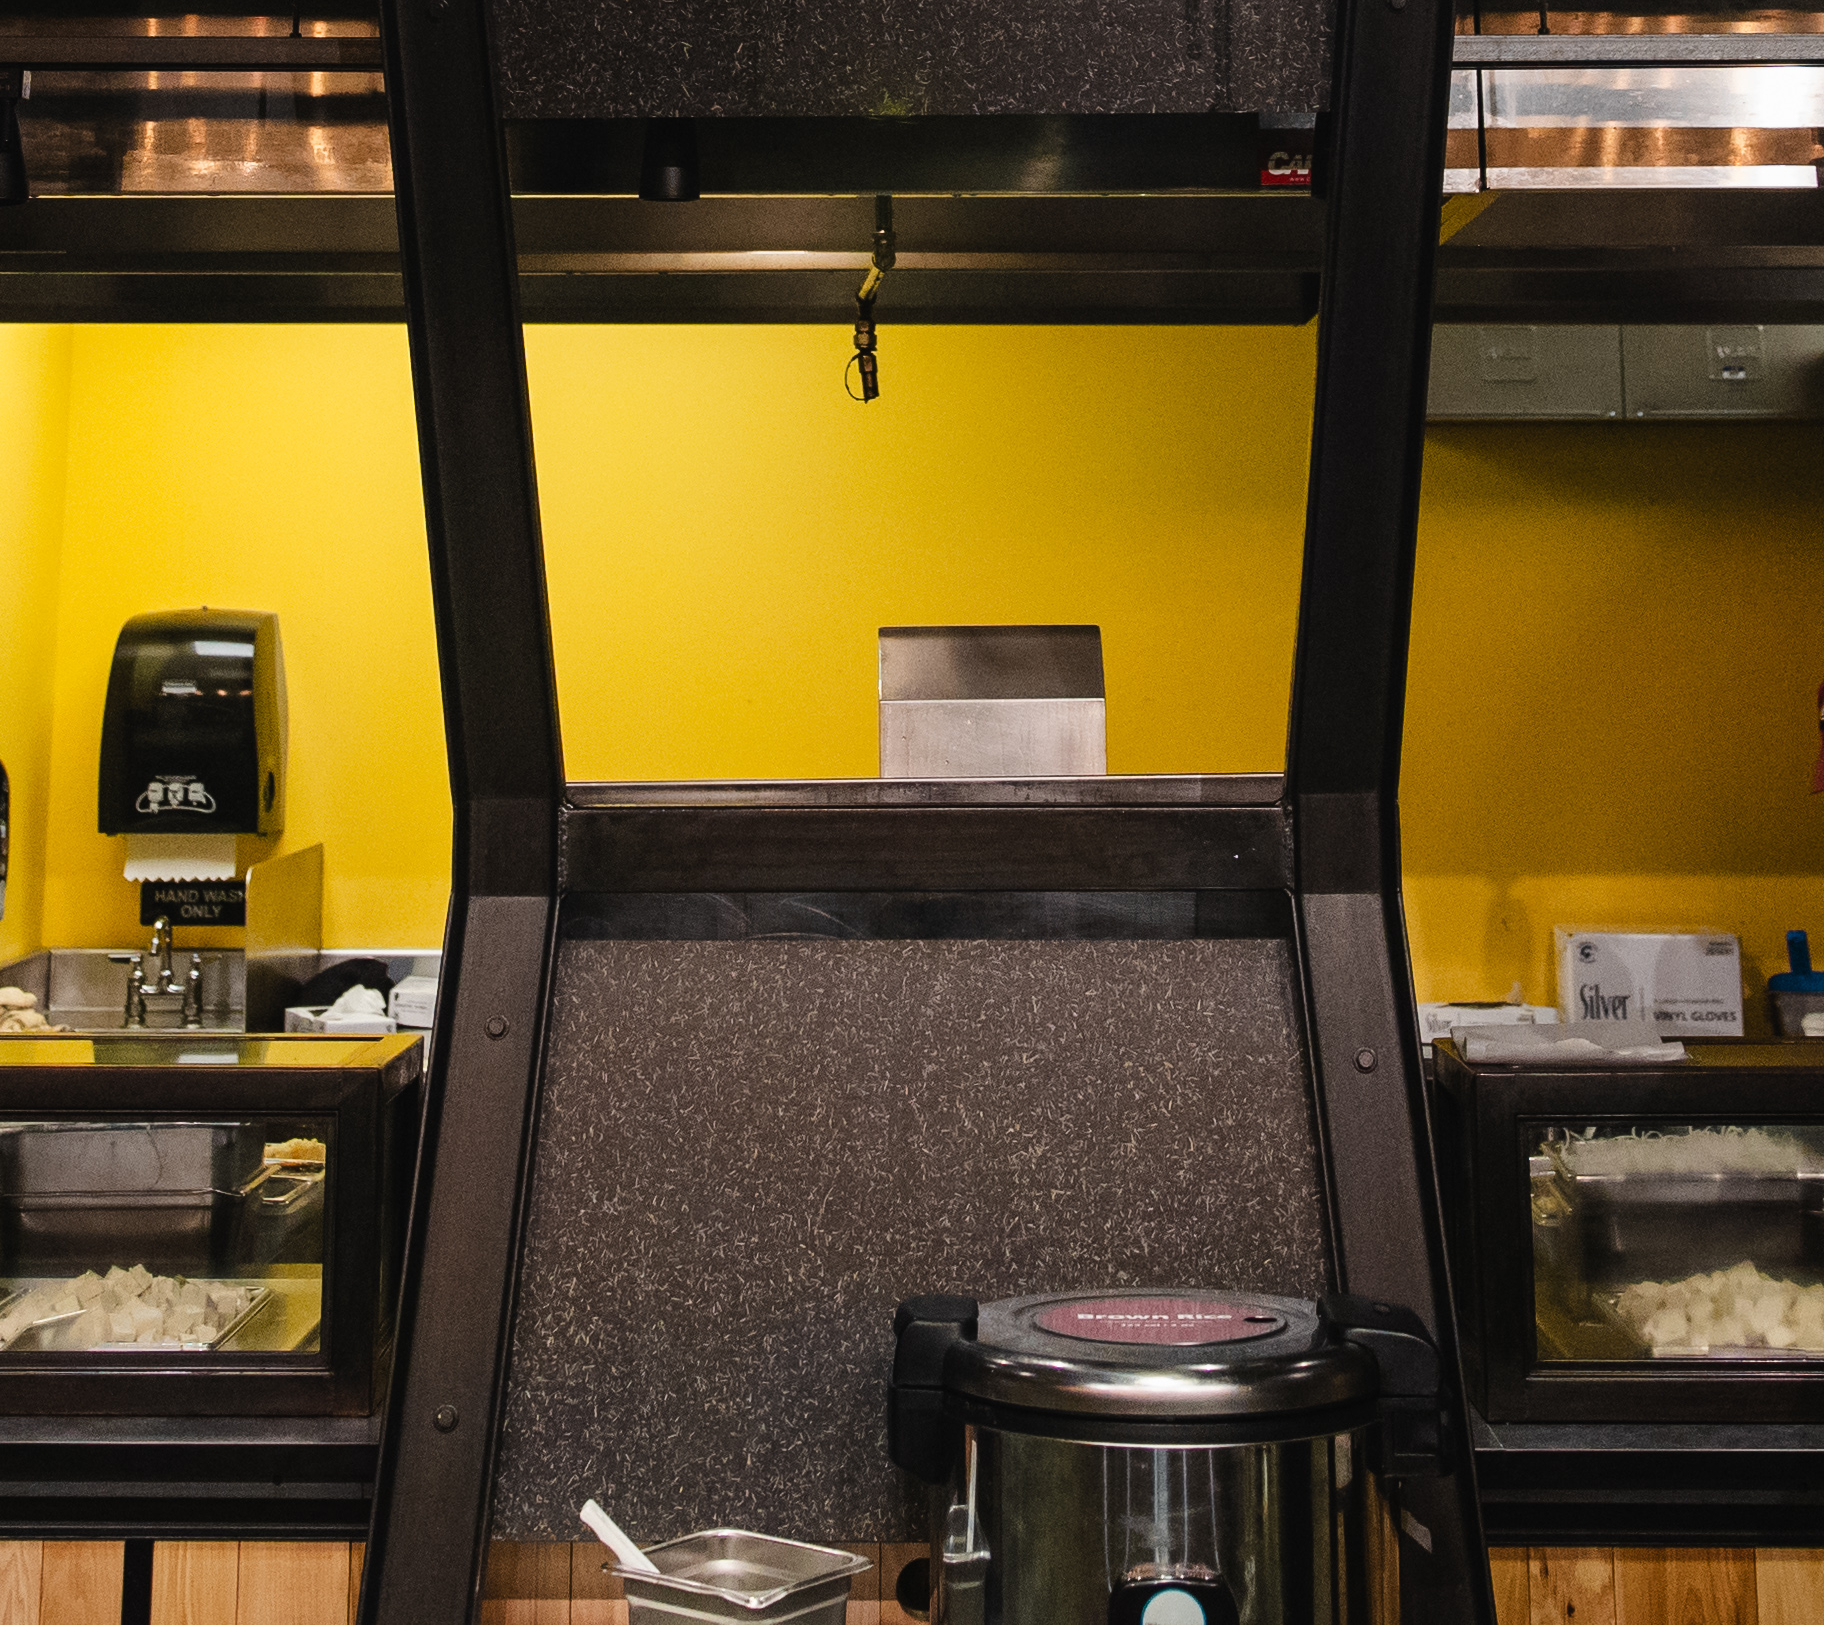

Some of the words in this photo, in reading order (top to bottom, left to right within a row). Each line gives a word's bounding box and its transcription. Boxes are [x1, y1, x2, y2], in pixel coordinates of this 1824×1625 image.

[154, 890, 200, 904] HAND
[180, 905, 223, 918] ONLY
[1579, 983, 1630, 1021] Silver
[1691, 1011, 1738, 1023] GLOVES
